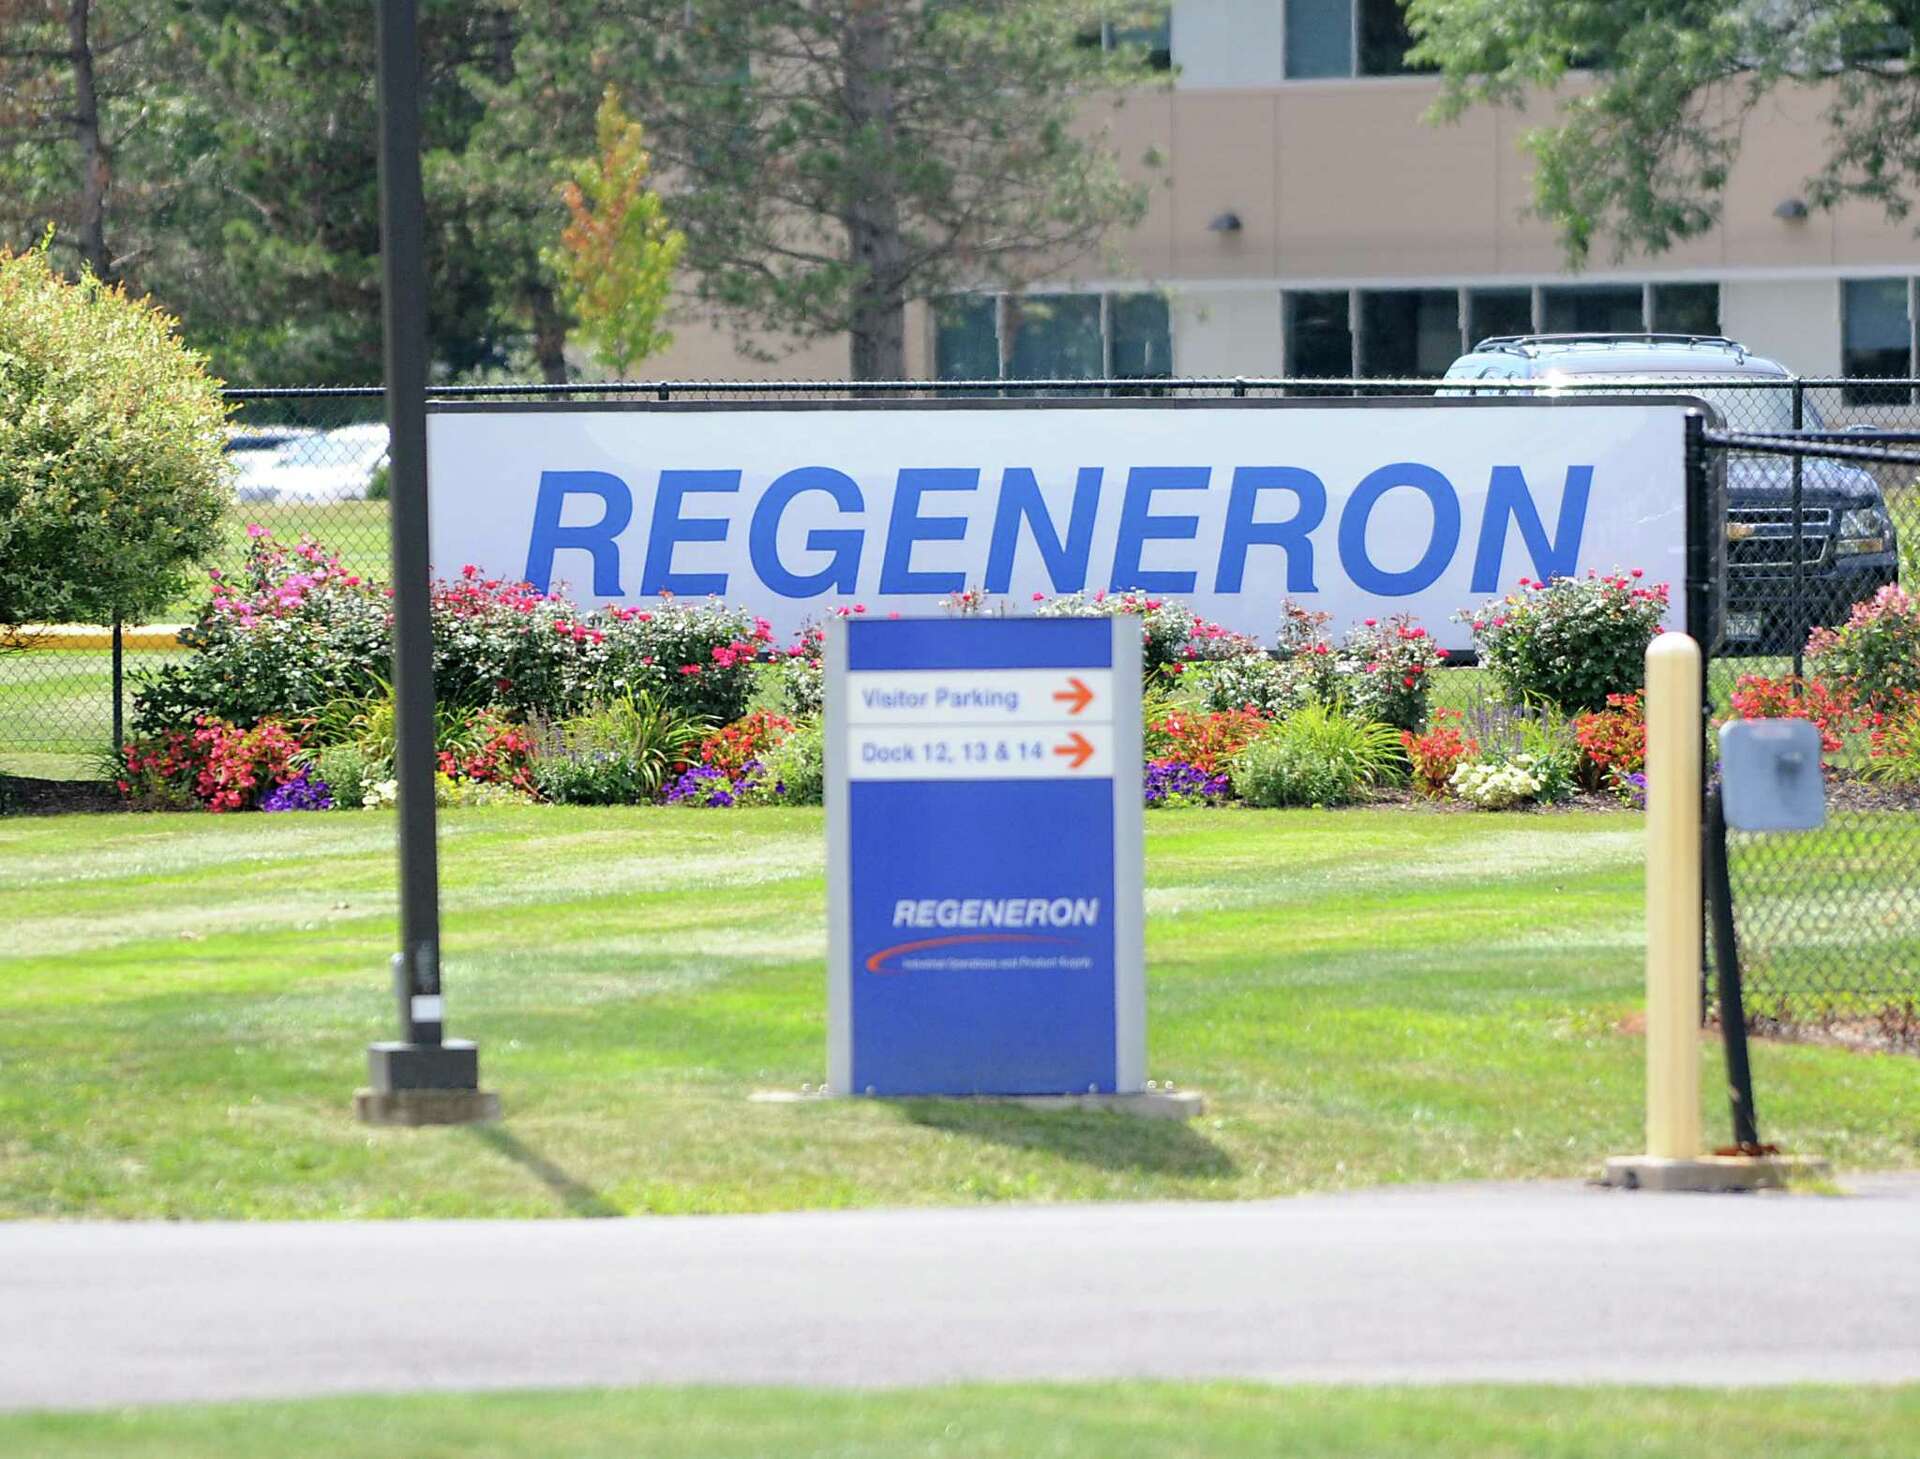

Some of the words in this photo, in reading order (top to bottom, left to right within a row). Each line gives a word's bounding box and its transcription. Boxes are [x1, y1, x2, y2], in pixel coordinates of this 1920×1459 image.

[525, 462, 1594, 598] REGENERON
[863, 687, 928, 709] Visitor
[935, 686, 1019, 712] Parking
[862, 742, 914, 763] Dock
[923, 741, 954, 765] 12,
[963, 741, 988, 762] 13
[995, 741, 1011, 762] &
[1019, 740, 1043, 761] 14
[892, 897, 1098, 928] REGENERON
